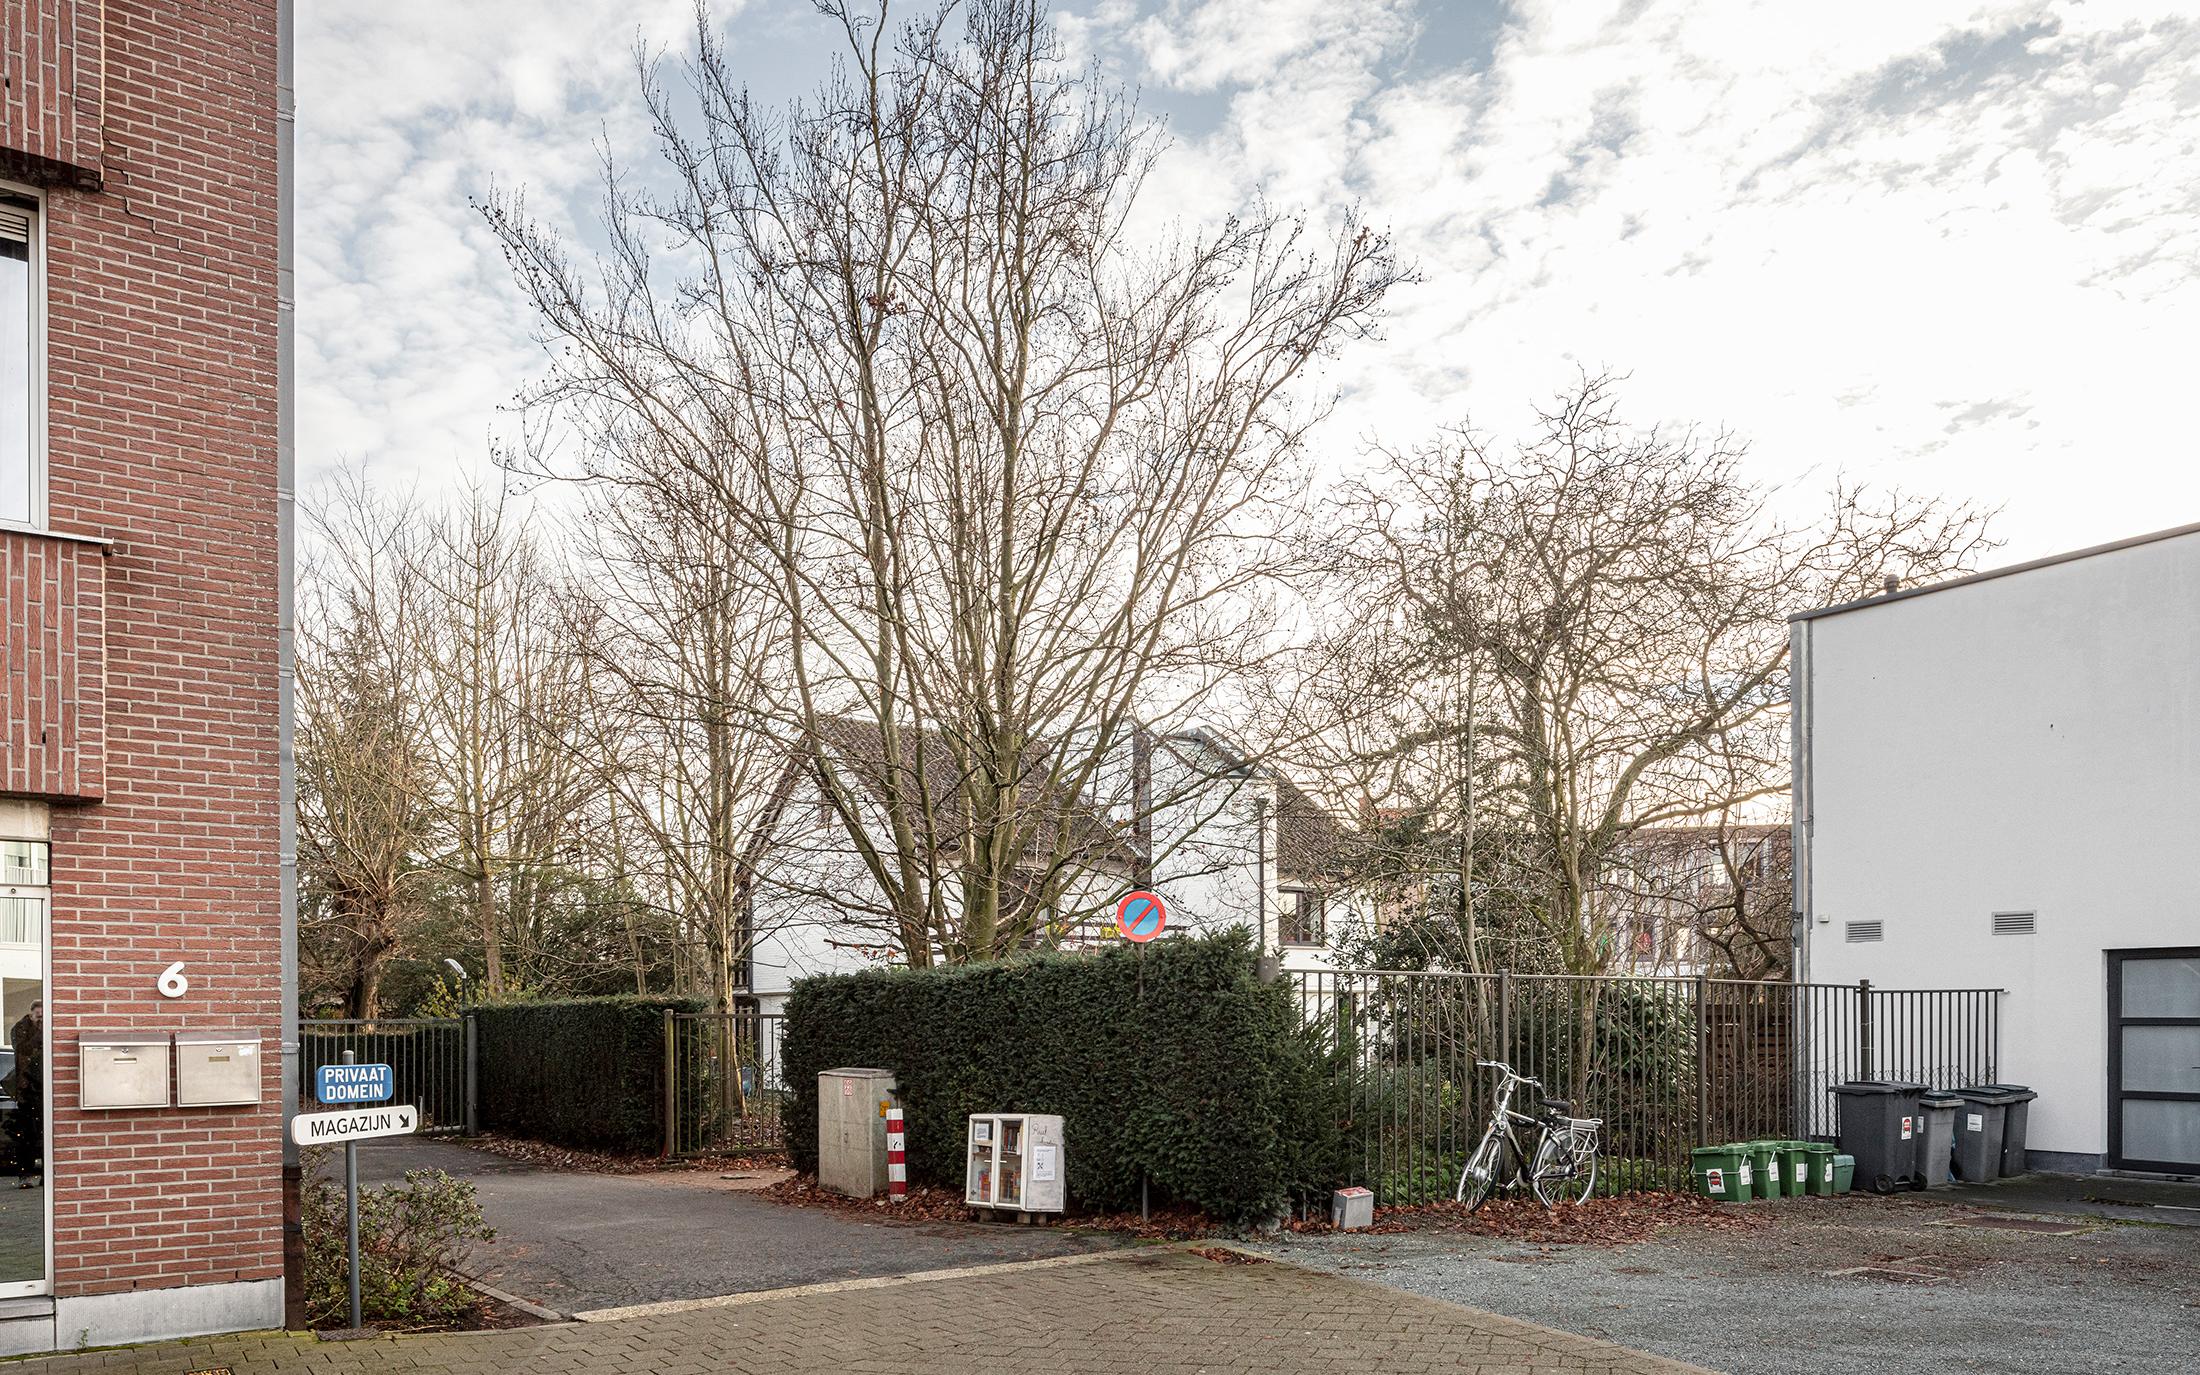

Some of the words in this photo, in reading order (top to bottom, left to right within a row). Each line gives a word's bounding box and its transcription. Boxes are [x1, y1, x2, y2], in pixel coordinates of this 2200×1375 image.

[157, 961, 188, 998] 6
[325, 1067, 387, 1083] PRIVAAT
[326, 1083, 384, 1100] DOMEIN
[311, 1114, 391, 1137] MAGAZIJN
